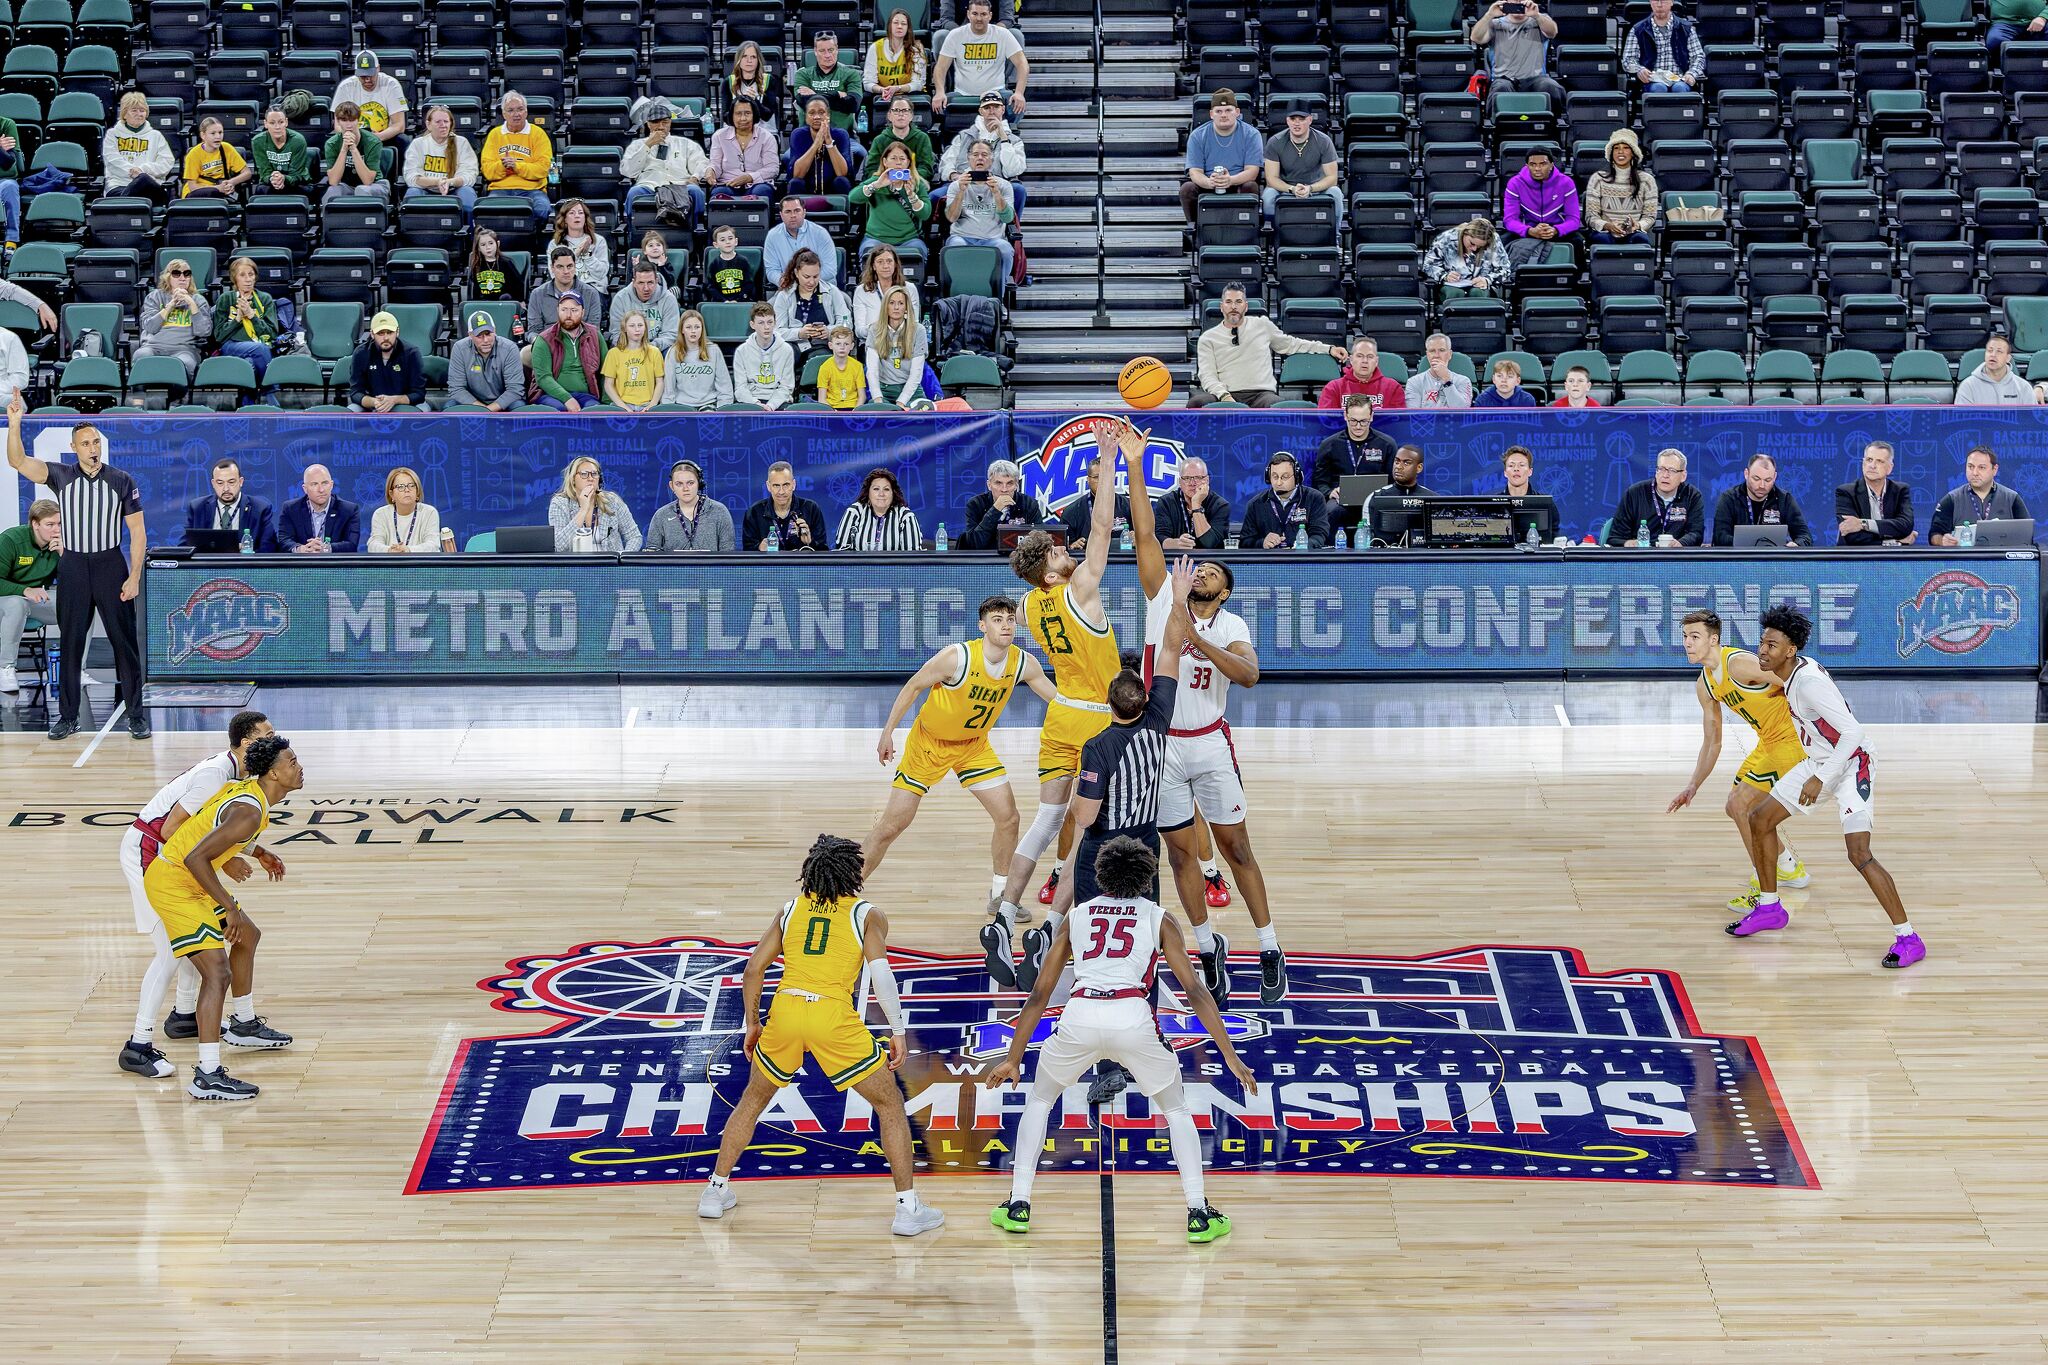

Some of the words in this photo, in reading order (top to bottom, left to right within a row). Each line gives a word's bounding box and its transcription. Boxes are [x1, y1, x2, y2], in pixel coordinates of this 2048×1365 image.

[963, 42, 998, 60] SIENA
[424, 154, 448, 173] SIEN
[675, 362, 713, 376] Saints
[1125, 359, 1157, 380] Wilson
[1057, 424, 1086, 444] METRO
[1517, 433, 1596, 446] BASKETBALL
[1757, 433, 1838, 446] BASKETBALL
[1993, 431, 2048, 444] BASKETB
[333, 440, 412, 452] BASKETBALL
[567, 438, 647, 451] BASKETBALL
[807, 438, 886, 451] BASKETBALL
[333, 454, 414, 466] CHAMPIONSHIP
[807, 452, 888, 465] CHAMPIONSHIP
[327, 589, 578, 653] METRO
[606, 587, 968, 652] ATLANTIC
[1896, 587, 2021, 659] MAAC
[168, 592, 290, 666] MAAC
[1040, 615, 1073, 655] 13
[1190, 666, 1212, 690] 33
[964, 704, 994, 729] 21
[308, 797, 482, 806] WHELAN
[8, 808, 679, 828] BORDWALK
[1089, 906, 1121, 916] WEEKS
[1122, 905, 1138, 917] JR.
[803, 917, 831, 955] 0
[1082, 918, 1137, 961] 35
[1272, 1062, 1665, 1076] BASKETBALL
[1222, 1138, 1366, 1154] CITY
